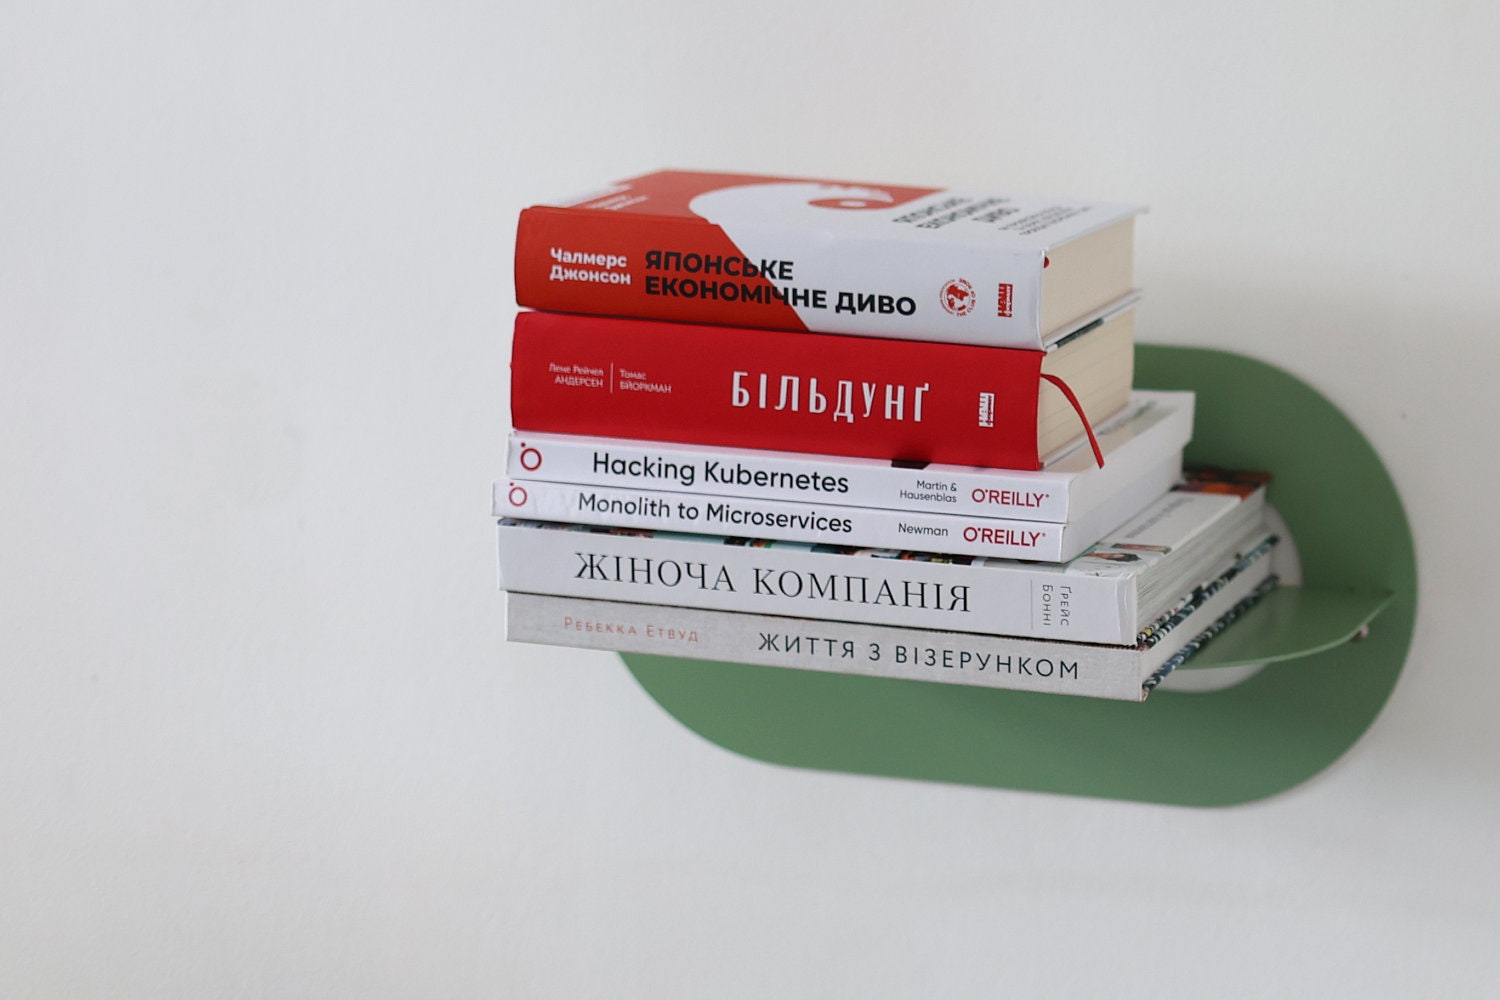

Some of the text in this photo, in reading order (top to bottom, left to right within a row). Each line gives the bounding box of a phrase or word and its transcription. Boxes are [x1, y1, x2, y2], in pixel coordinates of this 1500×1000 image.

[550, 248, 627, 268] Чалмерс
[645, 250, 794, 281] ЯПОНСЬКЕ
[550, 265, 631, 285] Джонсон
[645, 276, 828, 309] ЕКОНОМІЧНЕ
[836, 292, 917, 316] ДИВО
[554, 375, 604, 388] АНДЕРСЕН
[619, 369, 647, 380] Томас
[620, 380, 672, 393] БЙОРКМАН
[732, 371, 929, 423] БІЛЬДУНҐ
[593, 452, 850, 494] Hacking Kubernetes
[900, 490, 957, 503] Hausenblas
[917, 480, 957, 492] Martin &
[578, 493, 853, 533] Monolith to Microservices
[898, 523, 949, 537] Newman
[573, 552, 971, 613] ЖІНОЧА КОМПАНІЯ
[1042, 584, 1053, 626] БОННІ
[758, 632, 1079, 680] ЖИТТЯ З ВІЗЕРУНКОМ
